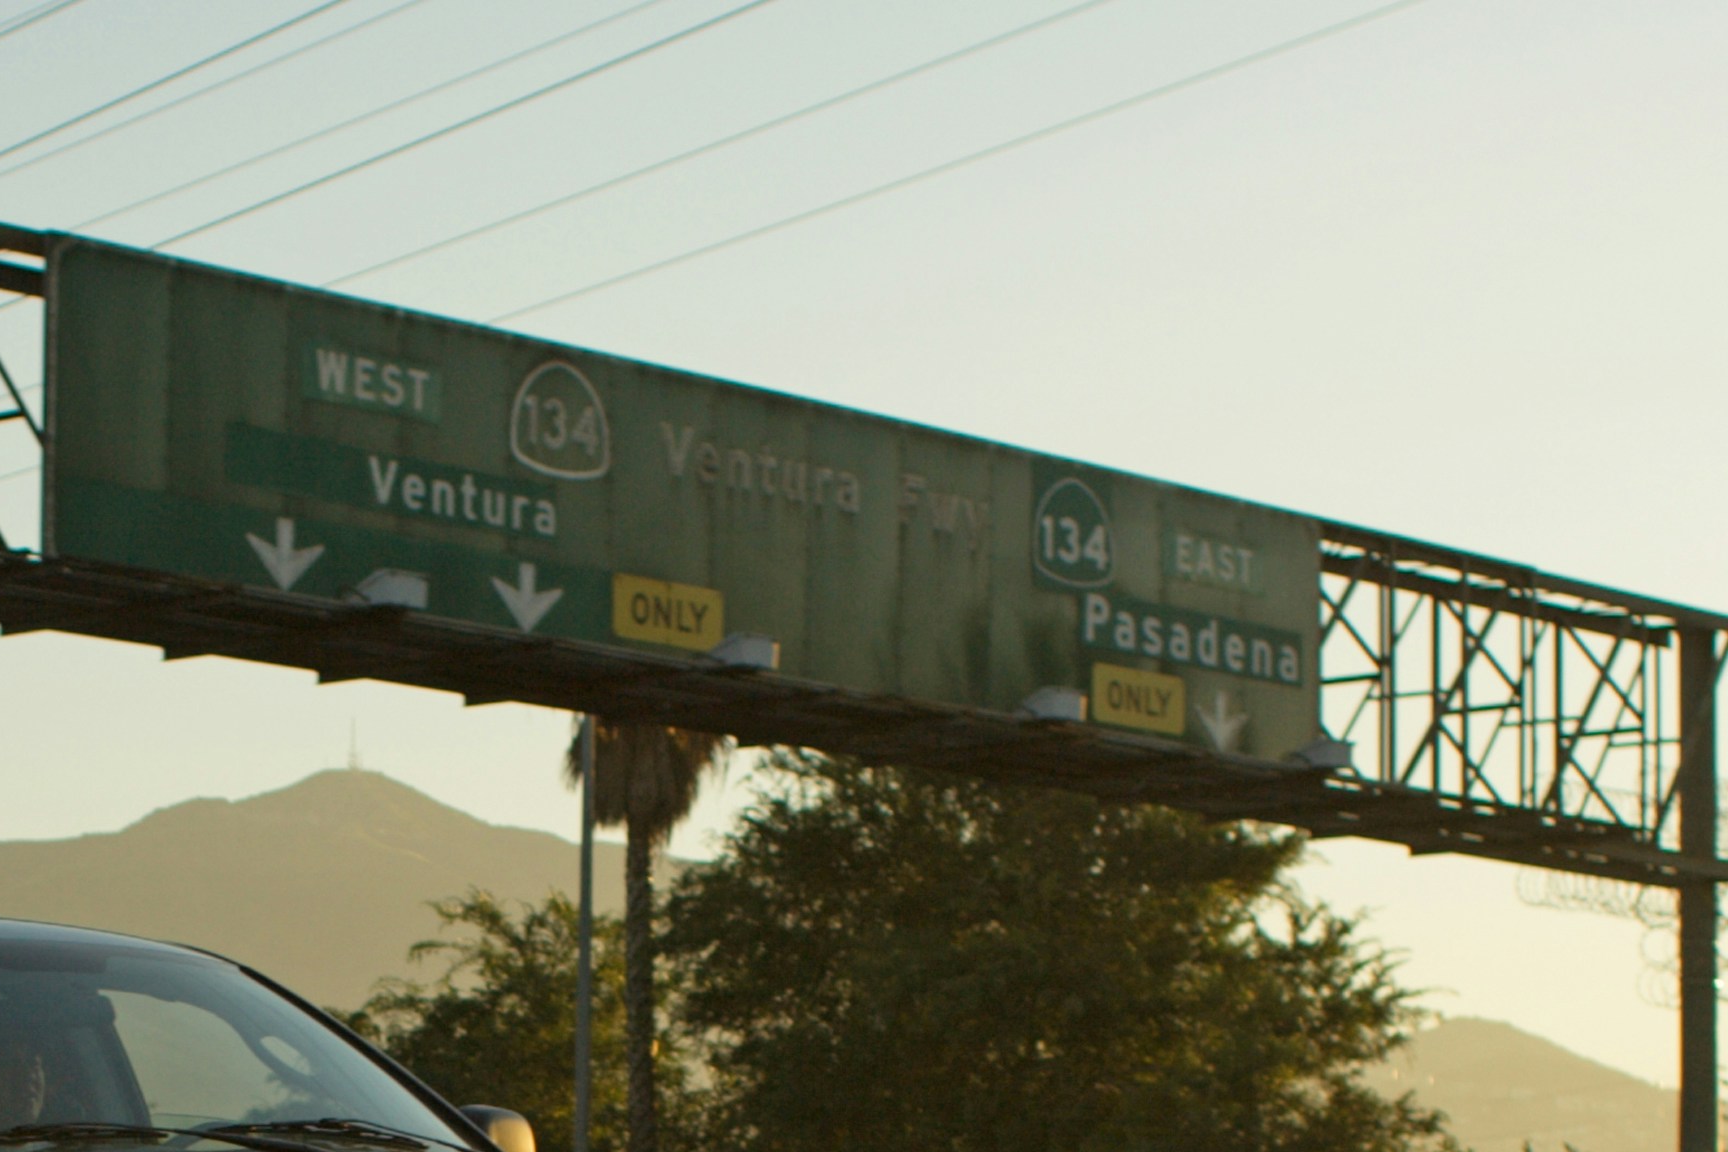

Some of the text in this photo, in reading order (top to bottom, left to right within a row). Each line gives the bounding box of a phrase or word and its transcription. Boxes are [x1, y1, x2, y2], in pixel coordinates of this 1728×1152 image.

[316, 348, 431, 411] WEST
[525, 395, 600, 455] 134
[369, 456, 557, 535] Ventura
[662, 420, 861, 514] Ventura
[1040, 515, 1110, 571] 134
[1176, 535, 1254, 586] EAST
[631, 592, 708, 635] ONLY
[1084, 594, 1301, 683] Pasadena
[1108, 678, 1173, 718] ONLY
